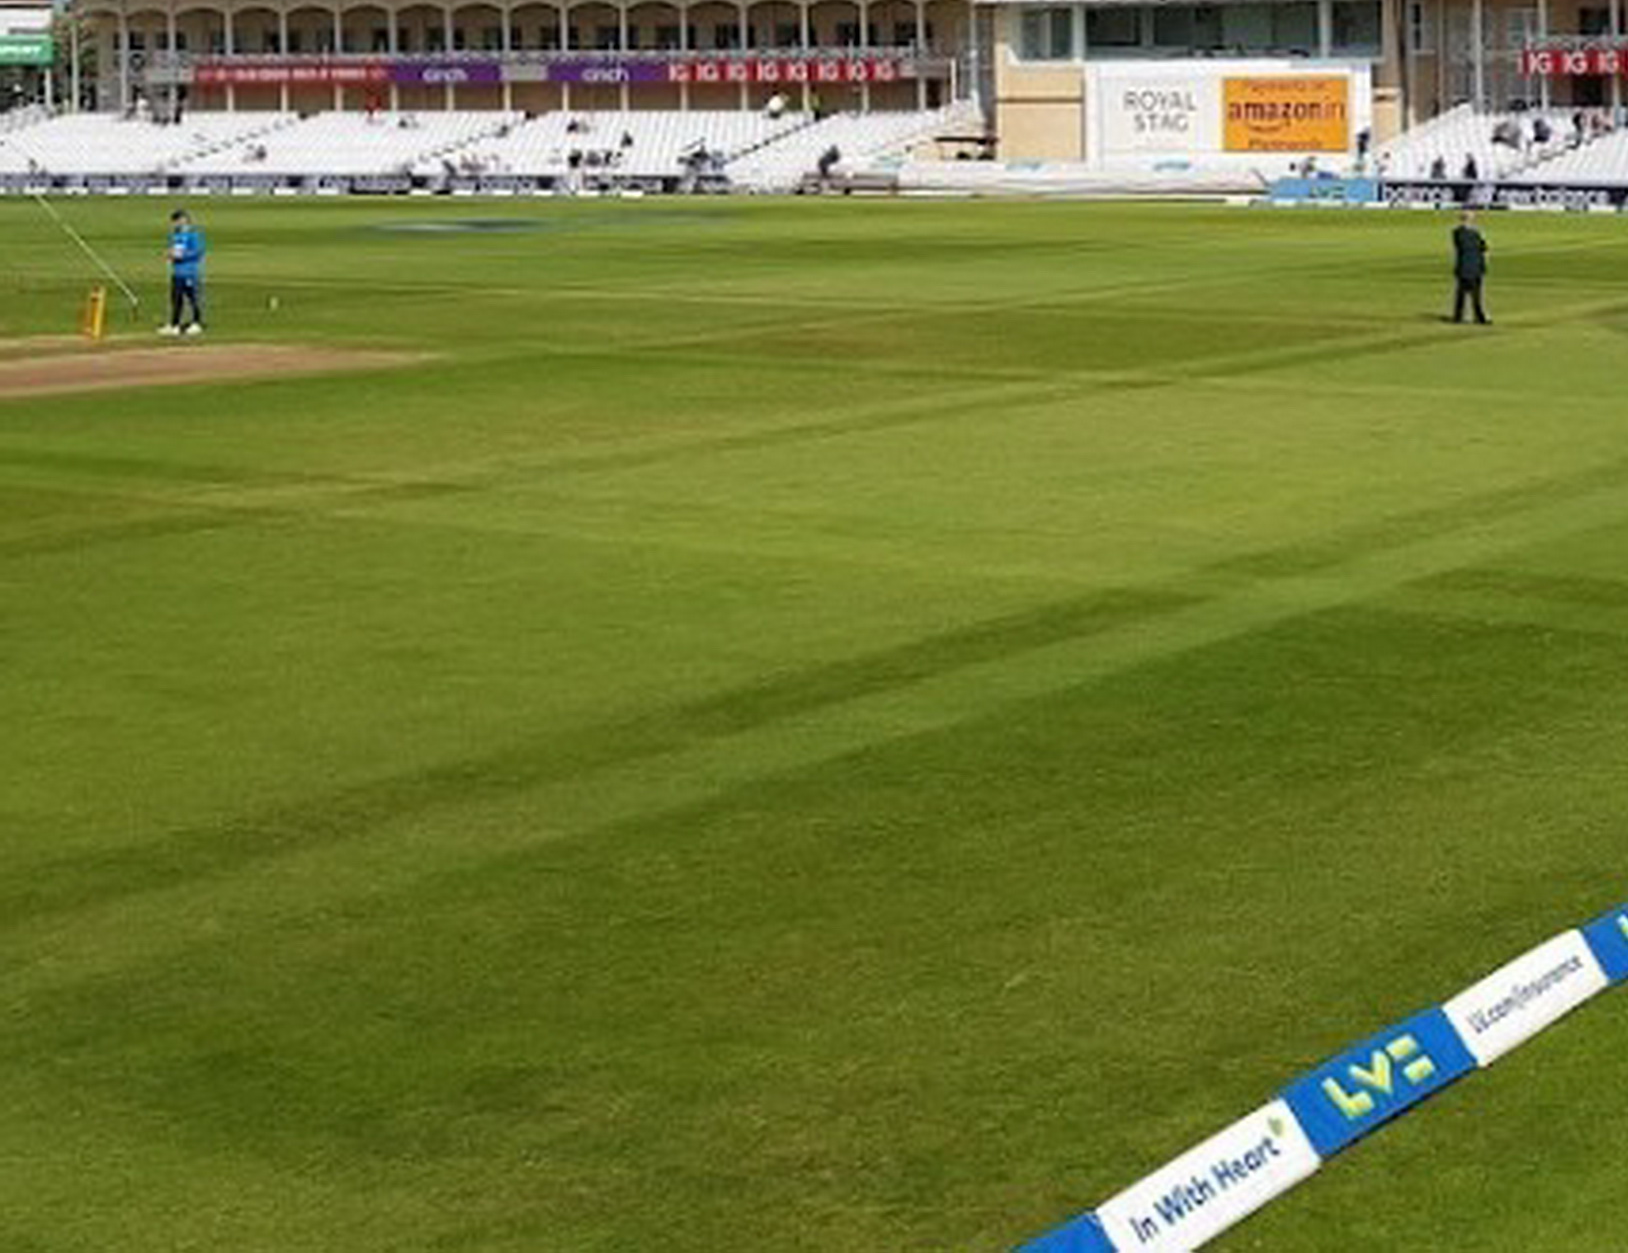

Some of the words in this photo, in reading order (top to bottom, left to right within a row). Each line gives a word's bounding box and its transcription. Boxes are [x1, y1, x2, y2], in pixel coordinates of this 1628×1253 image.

[1529, 51, 1551, 75] IG
[1563, 52, 1588, 75] IG
[1600, 50, 1619, 73] IG
[582, 66, 629, 83] cinch
[1123, 90, 1197, 112] ROYAL
[1133, 113, 1189, 132] STAG
[1129, 1215, 1160, 1245] In
[1152, 1177, 1218, 1227] With
[1210, 1134, 1282, 1192] Heart
